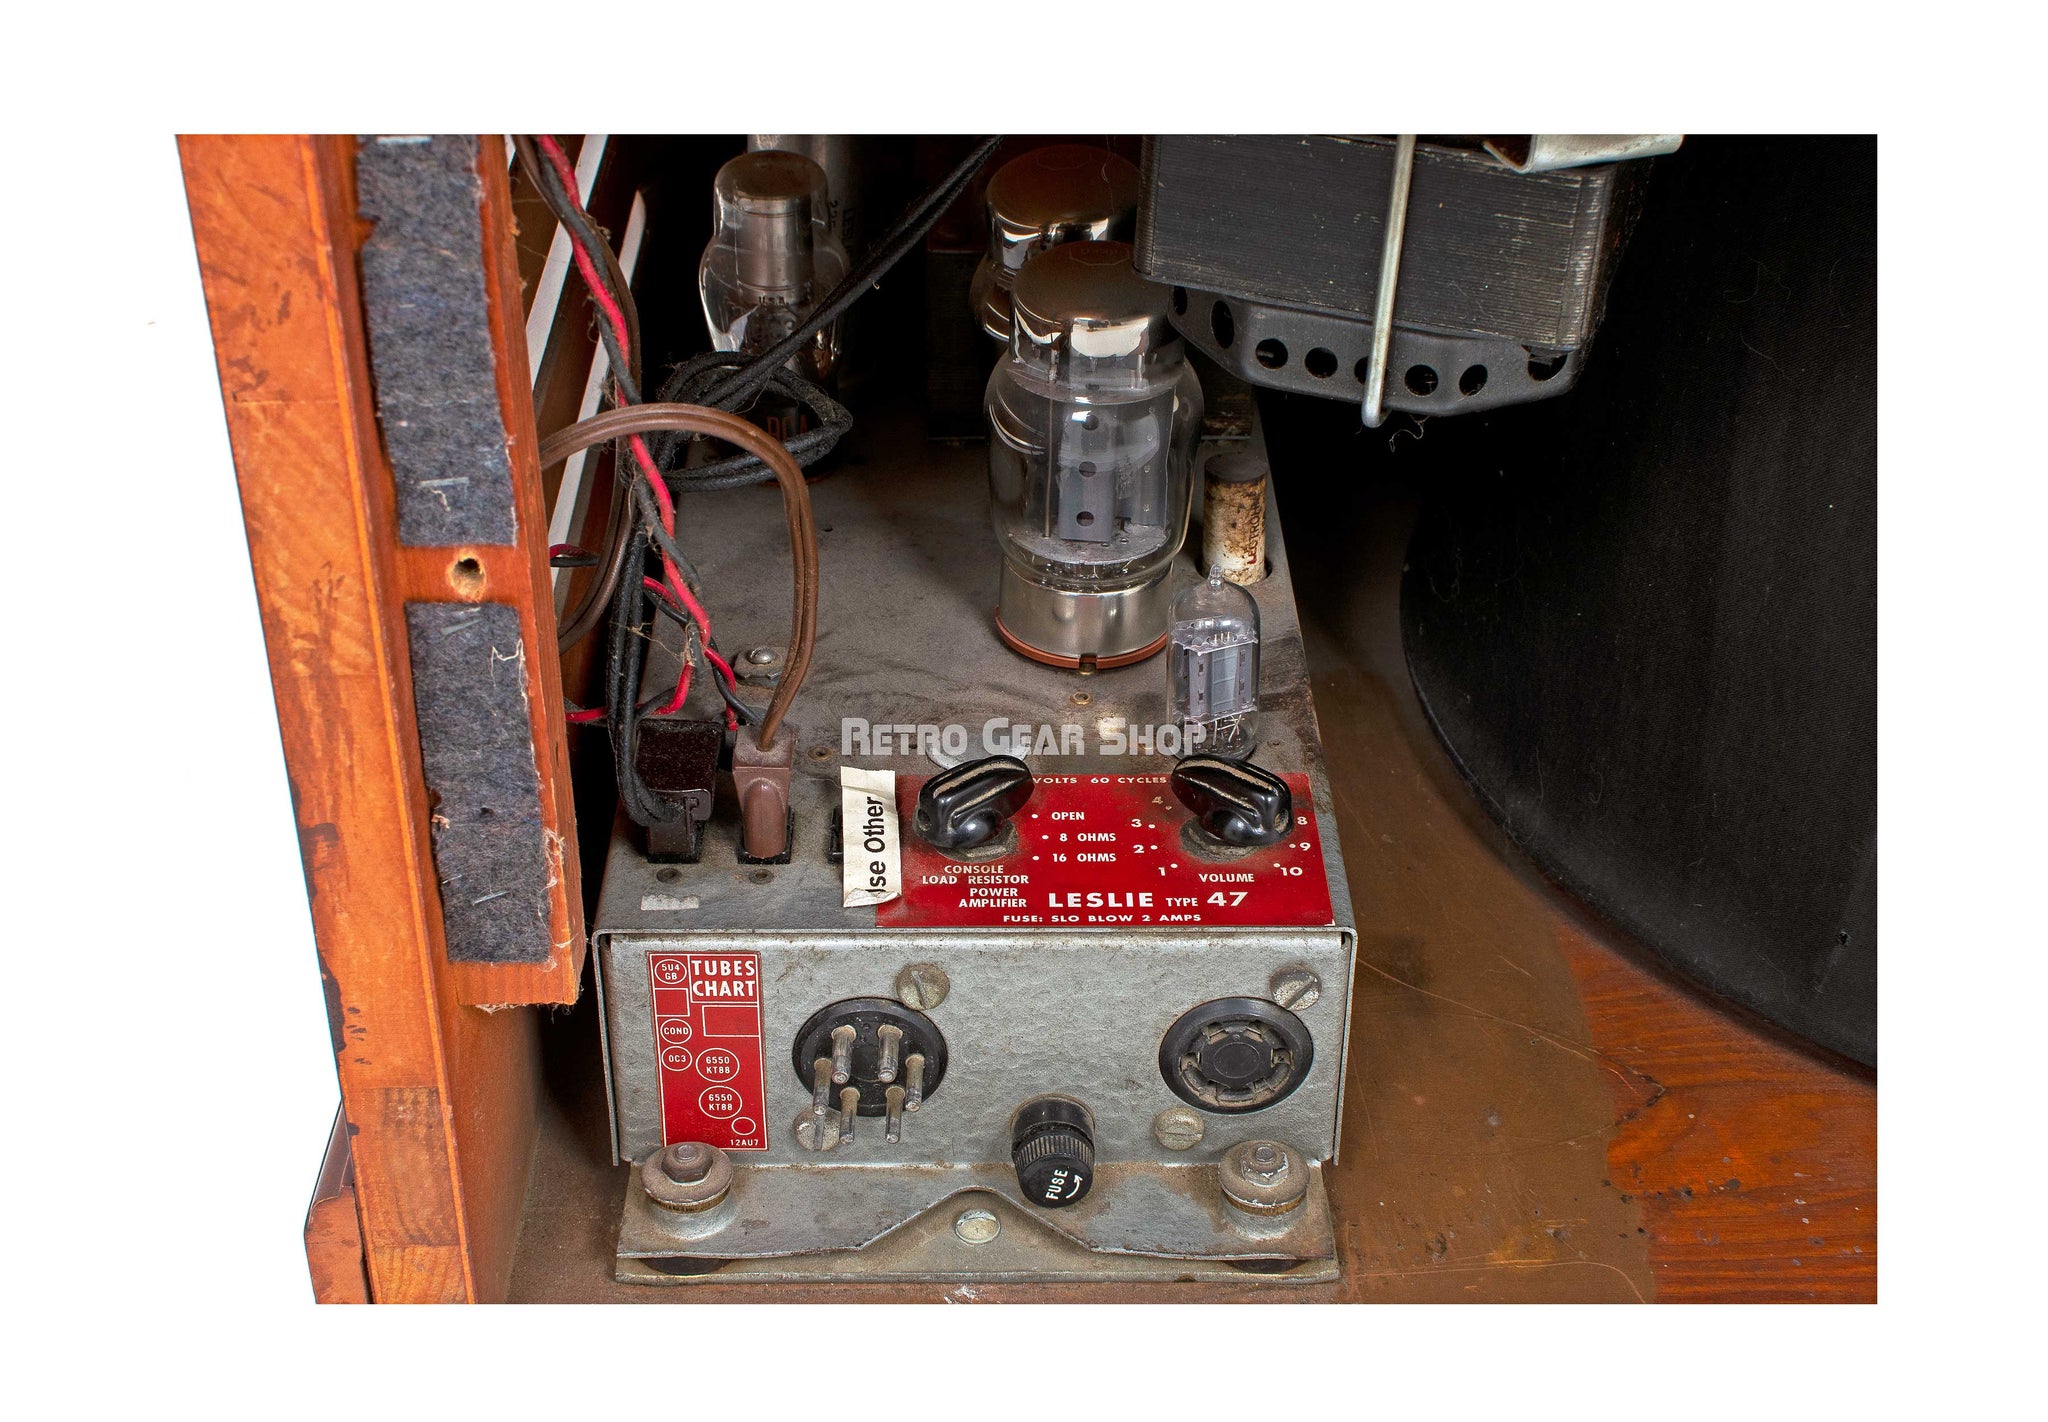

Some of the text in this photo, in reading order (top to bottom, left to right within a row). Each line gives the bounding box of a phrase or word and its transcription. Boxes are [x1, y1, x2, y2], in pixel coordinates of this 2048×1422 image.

[1117, 776, 1167, 784] CYCLES
[1051, 811, 1085, 820] OPEN
[1297, 816, 1308, 825] 8
[862, 796, 885, 853] Other
[1131, 818, 1142, 828] 3
[1059, 832, 1117, 842] 8 OHMS
[1132, 844, 1145, 854] 2
[1299, 842, 1311, 852] 9
[1052, 852, 1117, 862] 16 OHMS
[944, 864, 1004, 874] CONSOLE
[1158, 866, 1166, 876] 1
[1280, 866, 1303, 876] 10
[922, 874, 1029, 885] LOAD RESISTOR
[1198, 873, 1255, 883] VOLUME
[969, 887, 1018, 897] POWER
[958, 898, 1027, 908] AMPLIFIER
[1048, 891, 1249, 908] LESLIE TYPE 47
[1003, 914, 1202, 923] FUSE: SLO BLOW 2 AMPS
[661, 963, 681, 972] 5U4
[691, 960, 756, 977] TUBES
[664, 972, 678, 981] GB
[692, 980, 756, 997] CHART
[663, 1027, 689, 1036] COND
[705, 1056, 730, 1065] 6550
[706, 1066, 731, 1075] KT88
[708, 1093, 733, 1102] 6550
[708, 1103, 733, 1112] KT88
[730, 1138, 759, 1147] 12AU7
[1045, 1169, 1069, 1200] FUSE
